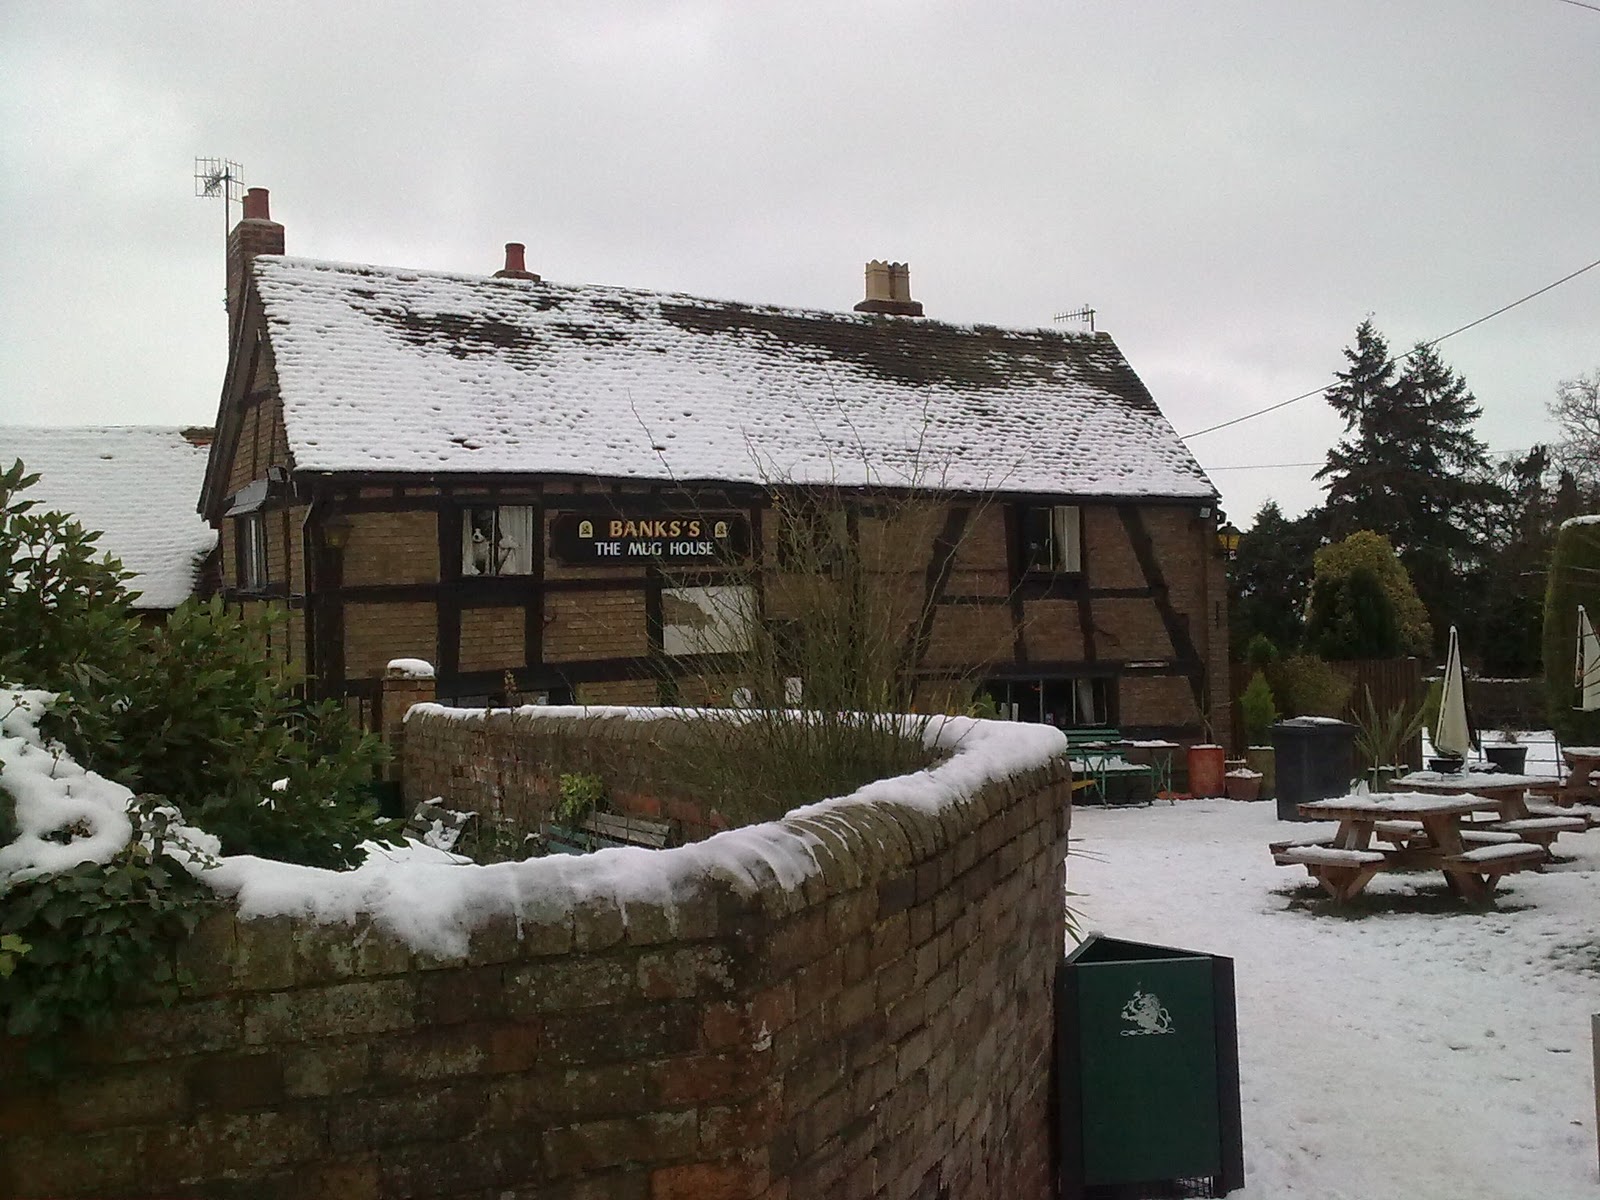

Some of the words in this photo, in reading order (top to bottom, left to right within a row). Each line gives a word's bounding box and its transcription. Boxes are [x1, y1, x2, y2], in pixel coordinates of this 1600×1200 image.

[609, 520, 700, 538] BANKS'S
[595, 542, 621, 556] THE
[628, 542, 662, 556] MUG
[669, 542, 714, 556] HOUSE
